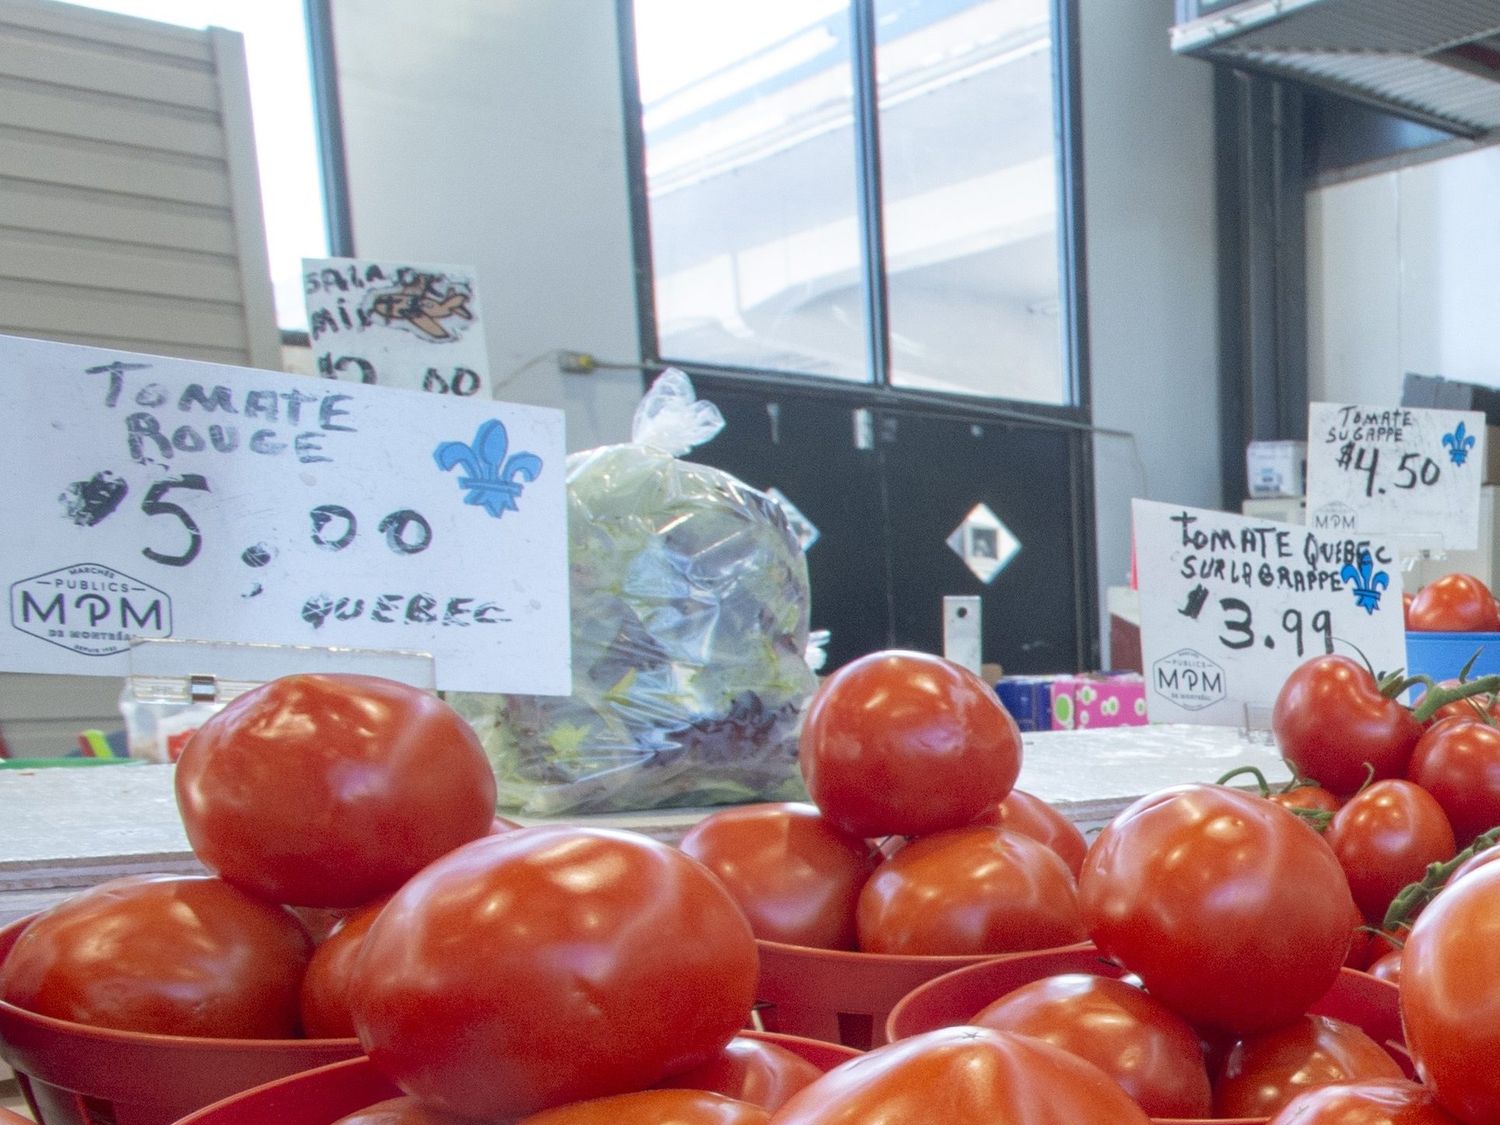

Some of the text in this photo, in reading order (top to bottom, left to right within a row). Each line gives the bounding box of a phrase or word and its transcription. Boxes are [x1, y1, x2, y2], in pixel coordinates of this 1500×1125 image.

[85, 361, 358, 432] TOMATE
[1337, 405, 1413, 427] TOMATE
[126, 412, 333, 463] ROUGE
[1335, 440, 1440, 497] $4.50
[1170, 511, 1294, 558] TOMATE
[55, 578, 129, 592] PUBLICS
[22, 590, 162, 630] MPM
[301, 592, 513, 629] QUEBEC
[1177, 582, 1335, 658] $3.99
[1158, 667, 1222, 694] MPM
